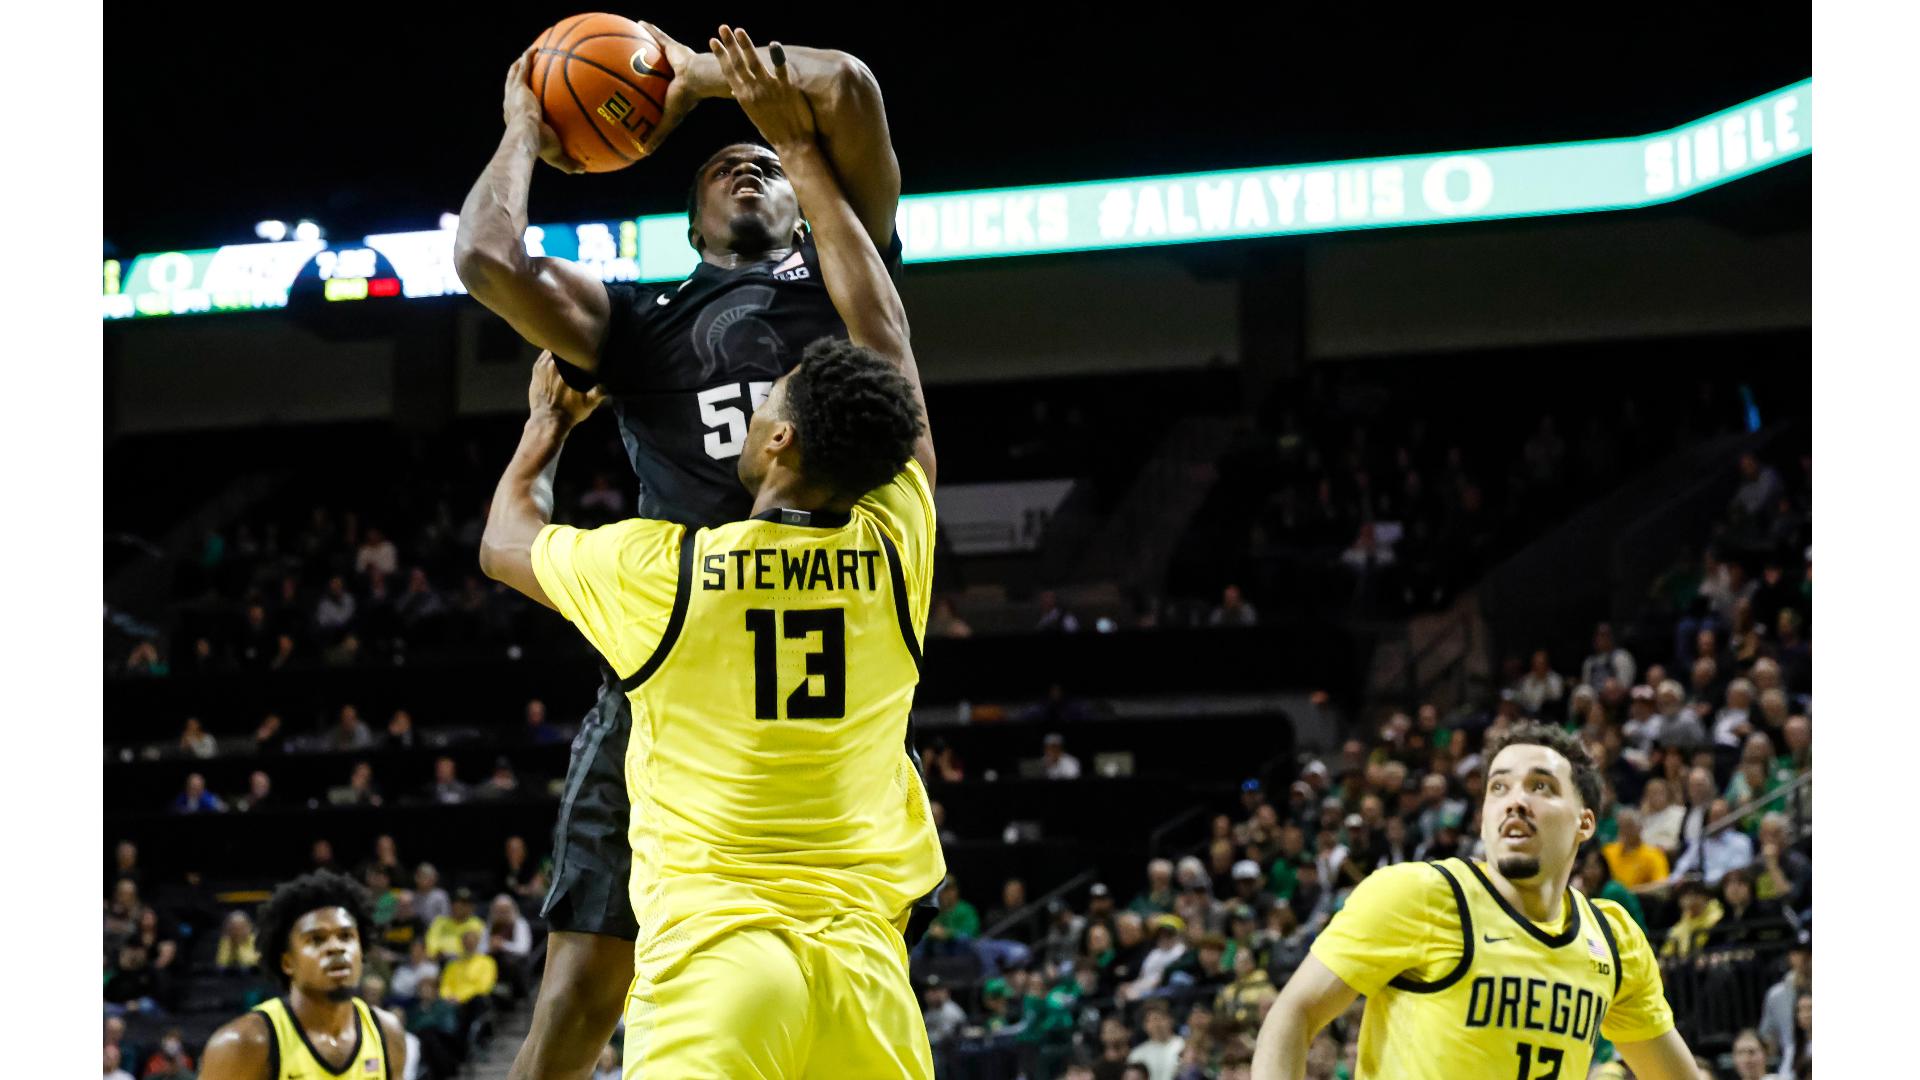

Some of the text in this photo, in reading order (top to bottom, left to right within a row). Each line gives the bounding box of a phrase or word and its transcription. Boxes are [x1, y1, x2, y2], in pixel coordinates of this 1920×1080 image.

[603, 91, 657, 145] ELIT
[703, 548, 880, 591] STEWART
[745, 607, 846, 720] 13
